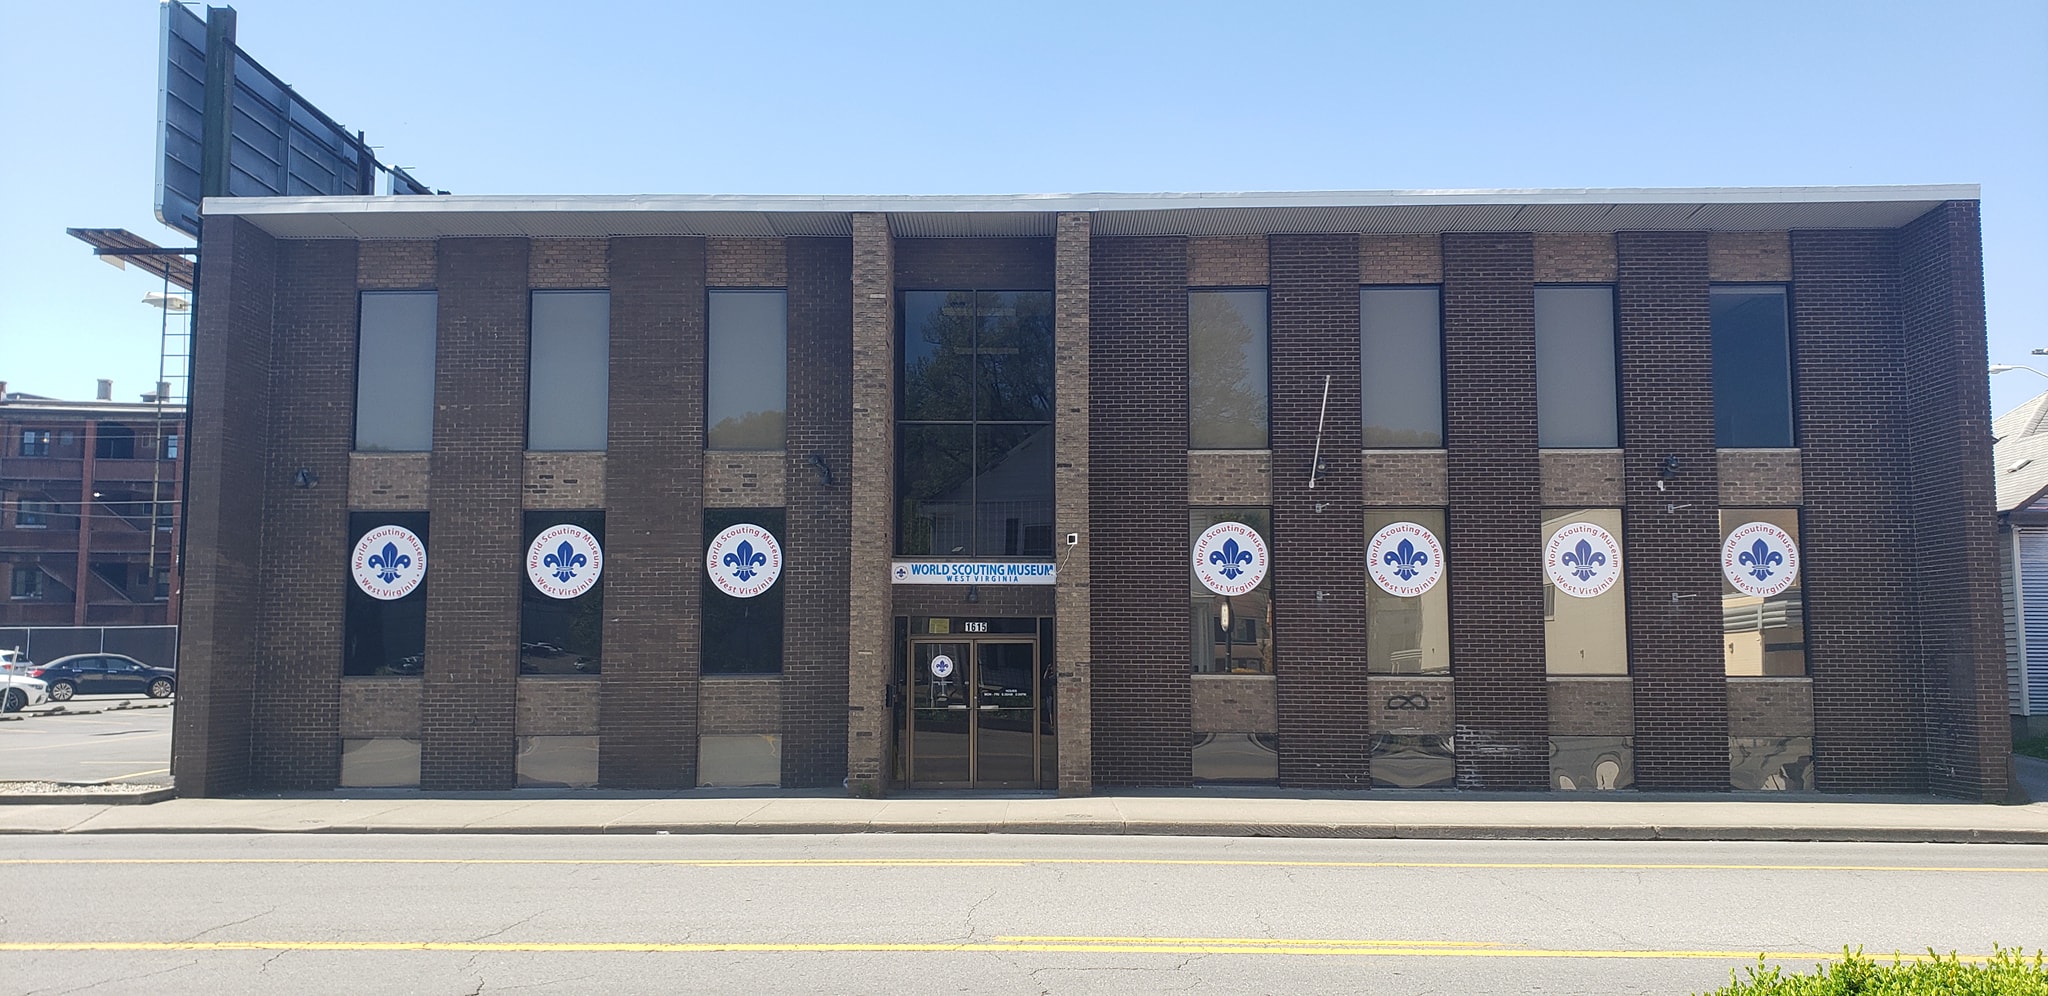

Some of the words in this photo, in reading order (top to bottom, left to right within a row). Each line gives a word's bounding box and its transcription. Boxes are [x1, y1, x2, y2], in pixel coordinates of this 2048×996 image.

[355, 543, 368, 570] World
[367, 528, 406, 544] Scouting
[406, 535, 423, 570] Museum
[530, 542, 543, 569] World
[541, 527, 581, 543] Scouting
[582, 534, 599, 569] Museum
[710, 541, 723, 569] World
[721, 526, 760, 542] Scouting
[761, 533, 779, 568] Museum
[1196, 539, 1208, 566] World
[1206, 524, 1246, 540] Scouting
[1246, 531, 1265, 566] Museum
[1370, 539, 1382, 567] World
[1380, 525, 1421, 540] Scouting
[1421, 531, 1440, 568] Museum
[1548, 540, 1560, 568] World
[1558, 525, 1598, 541] Scouting
[1599, 532, 1618, 568] Museum
[1725, 540, 1737, 567] World
[1734, 525, 1775, 540] Scouting
[1776, 531, 1796, 568] Museum
[911, 564, 950, 576] WORLD
[952, 564, 1005, 576] SCOUTING
[1007, 564, 1054, 576] MUSEUM
[362, 577, 381, 595] West
[383, 579, 417, 597] Virginia
[537, 576, 556, 594] West
[559, 578, 593, 596] Virginia
[718, 576, 737, 593] West
[739, 576, 773, 594] Virginia
[1204, 574, 1224, 591] West
[1226, 575, 1260, 593] Virginia
[1378, 574, 1398, 592] West
[1400, 576, 1435, 594] Virginia
[1556, 575, 1576, 593] West
[1579, 576, 1614, 595] Virginia
[1733, 574, 1754, 593] West
[1756, 576, 1791, 594] Virginia
[965, 622, 987, 632] 1615
